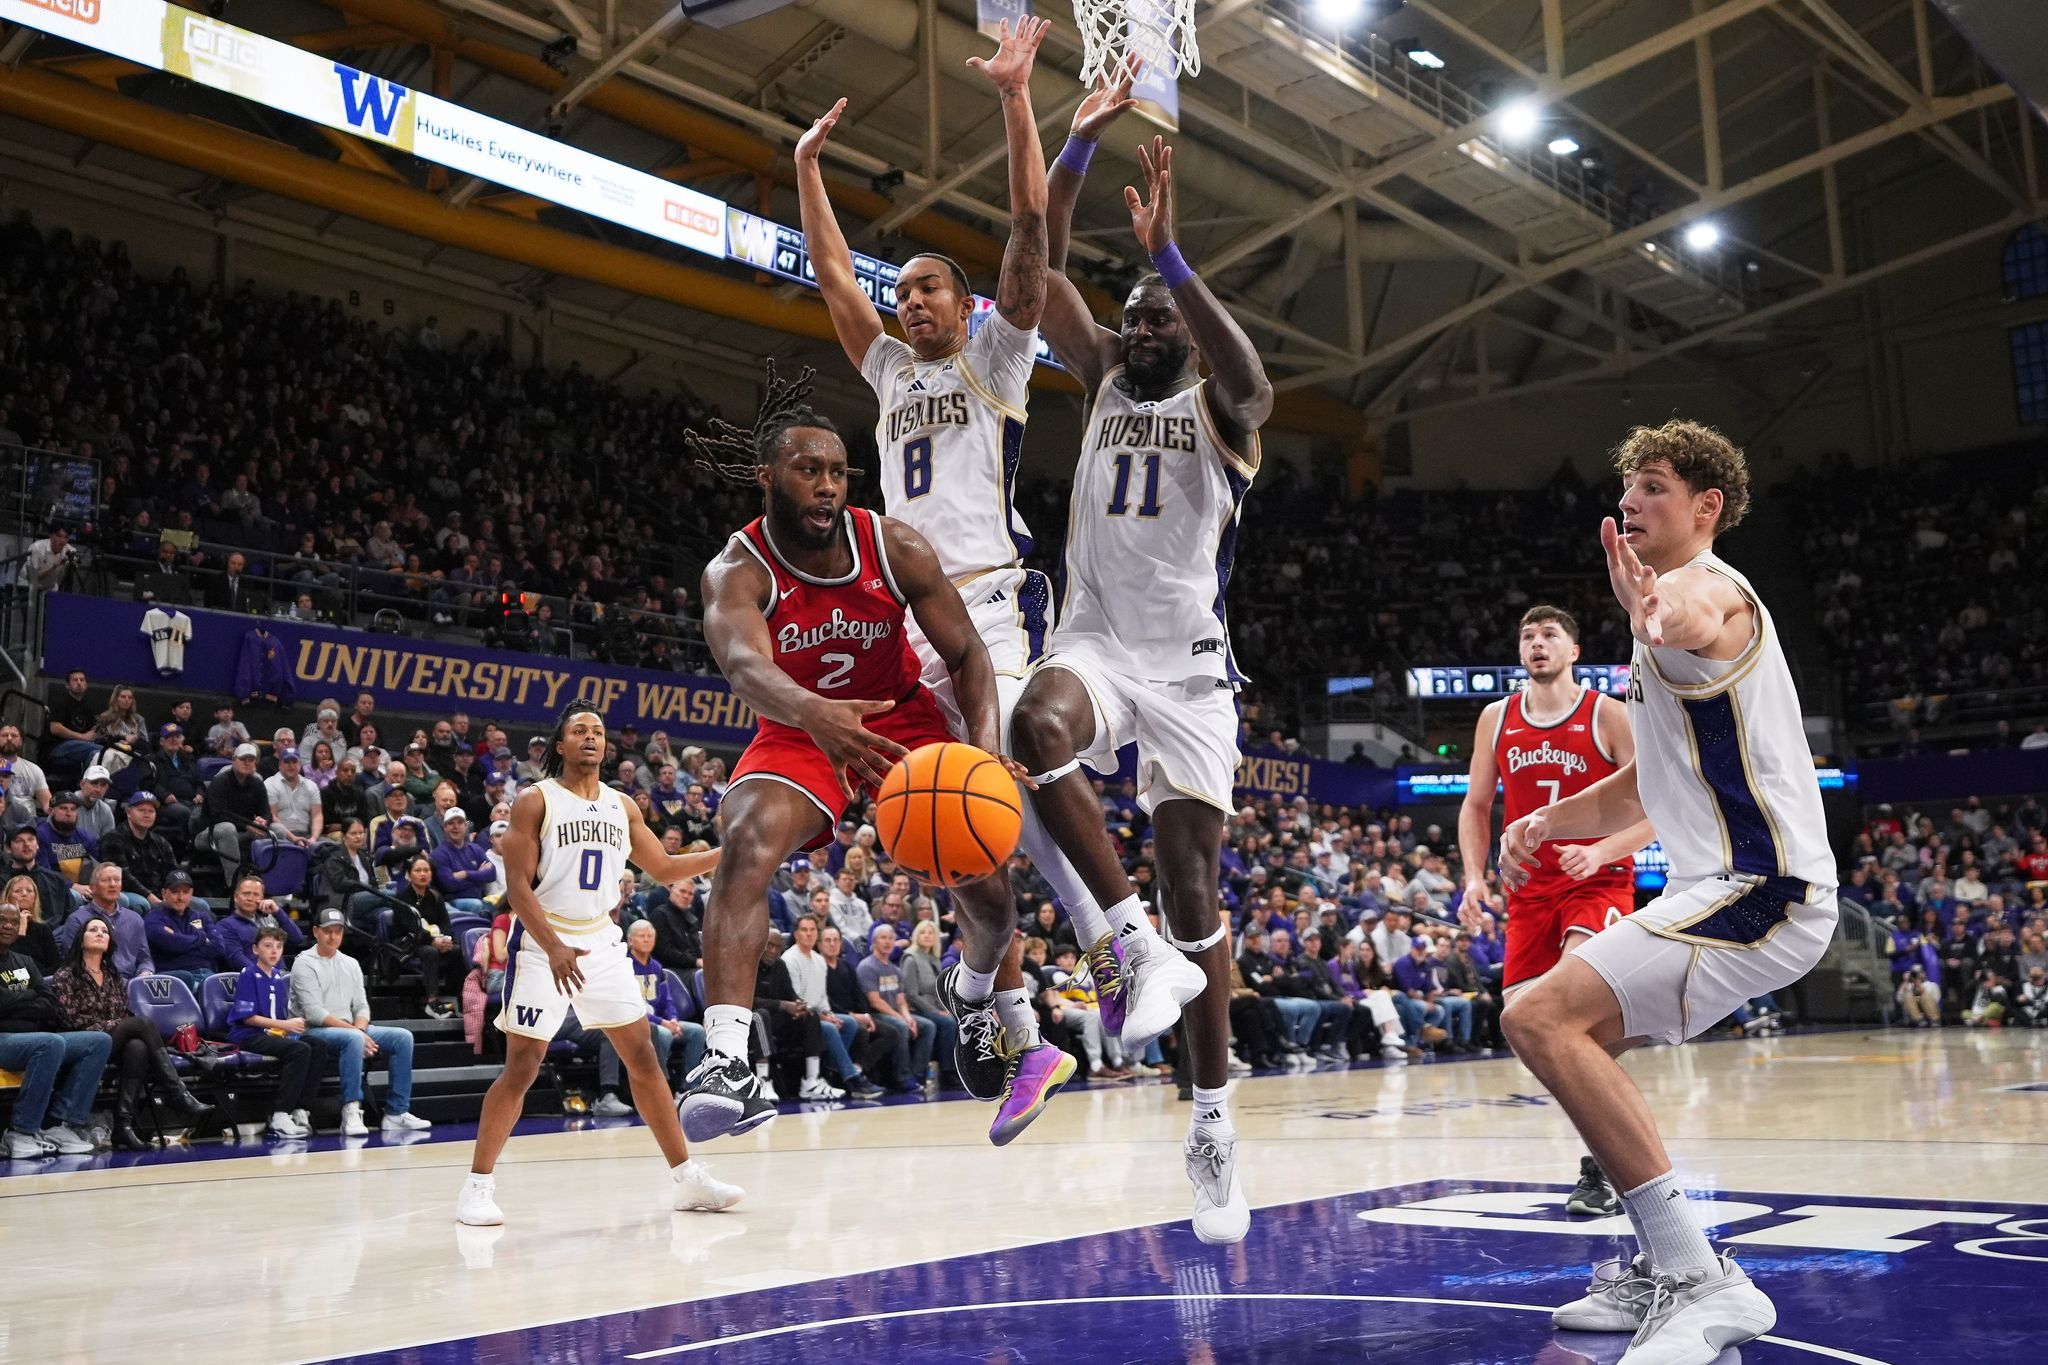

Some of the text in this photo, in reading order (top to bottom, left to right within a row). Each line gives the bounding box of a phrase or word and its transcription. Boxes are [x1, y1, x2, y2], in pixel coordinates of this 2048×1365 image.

[334, 62, 406, 136] W
[417, 116, 483, 152] Huskies
[778, 250, 797, 271] 47
[903, 434, 936, 503] 8
[1105, 452, 1164, 519] 11
[778, 607, 892, 654] Buckeyes
[295, 639, 570, 708] UNIVERSITY
[577, 675, 628, 715] OF
[816, 652, 855, 689] 2
[1507, 741, 1587, 775] Buckeyes
[1536, 780, 1560, 806] 7
[557, 820, 623, 851] HUSKIES
[579, 849, 603, 890] 0
[144, 978, 172, 999] W
[516, 1005, 543, 1027] W
